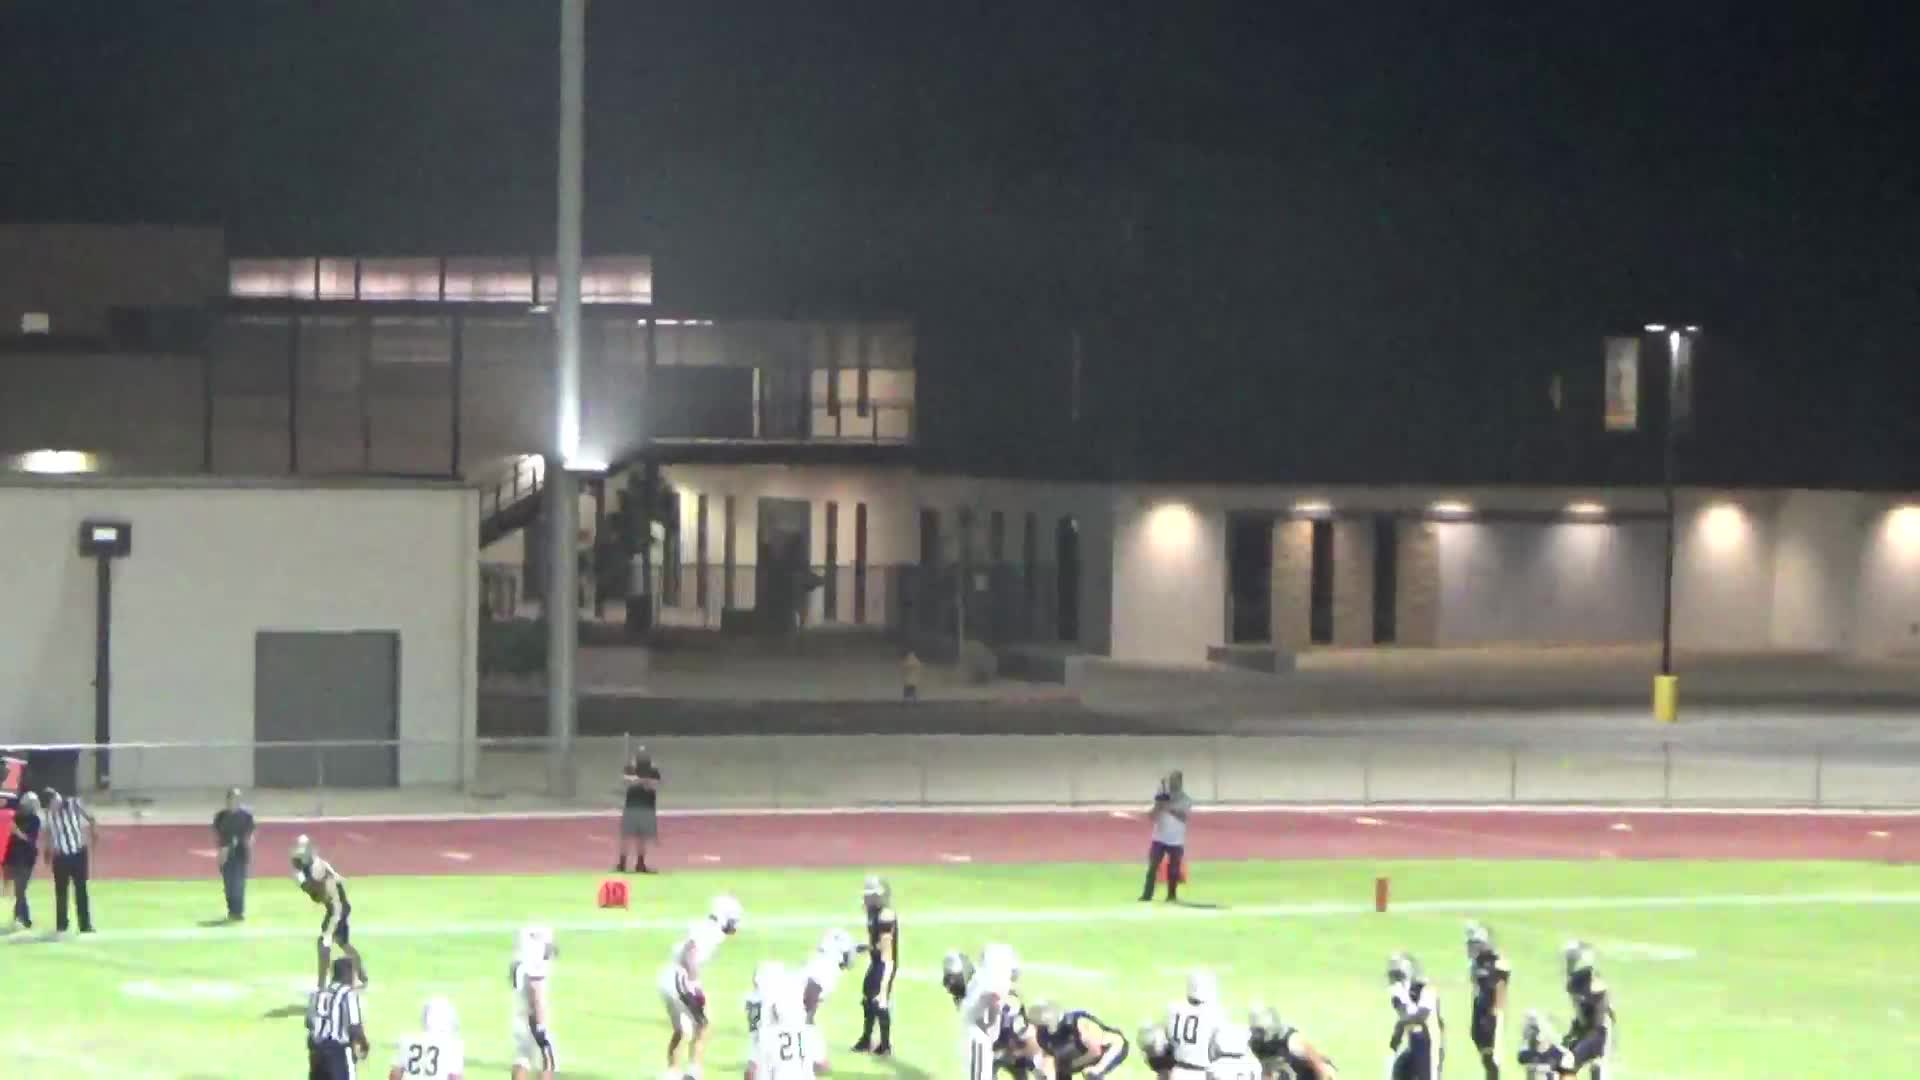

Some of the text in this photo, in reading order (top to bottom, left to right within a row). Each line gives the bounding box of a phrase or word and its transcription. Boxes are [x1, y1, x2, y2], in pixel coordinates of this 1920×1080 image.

[1173, 1013, 1199, 1044] 10
[407, 1043, 440, 1077] 23
[778, 1032, 806, 1062] 21
